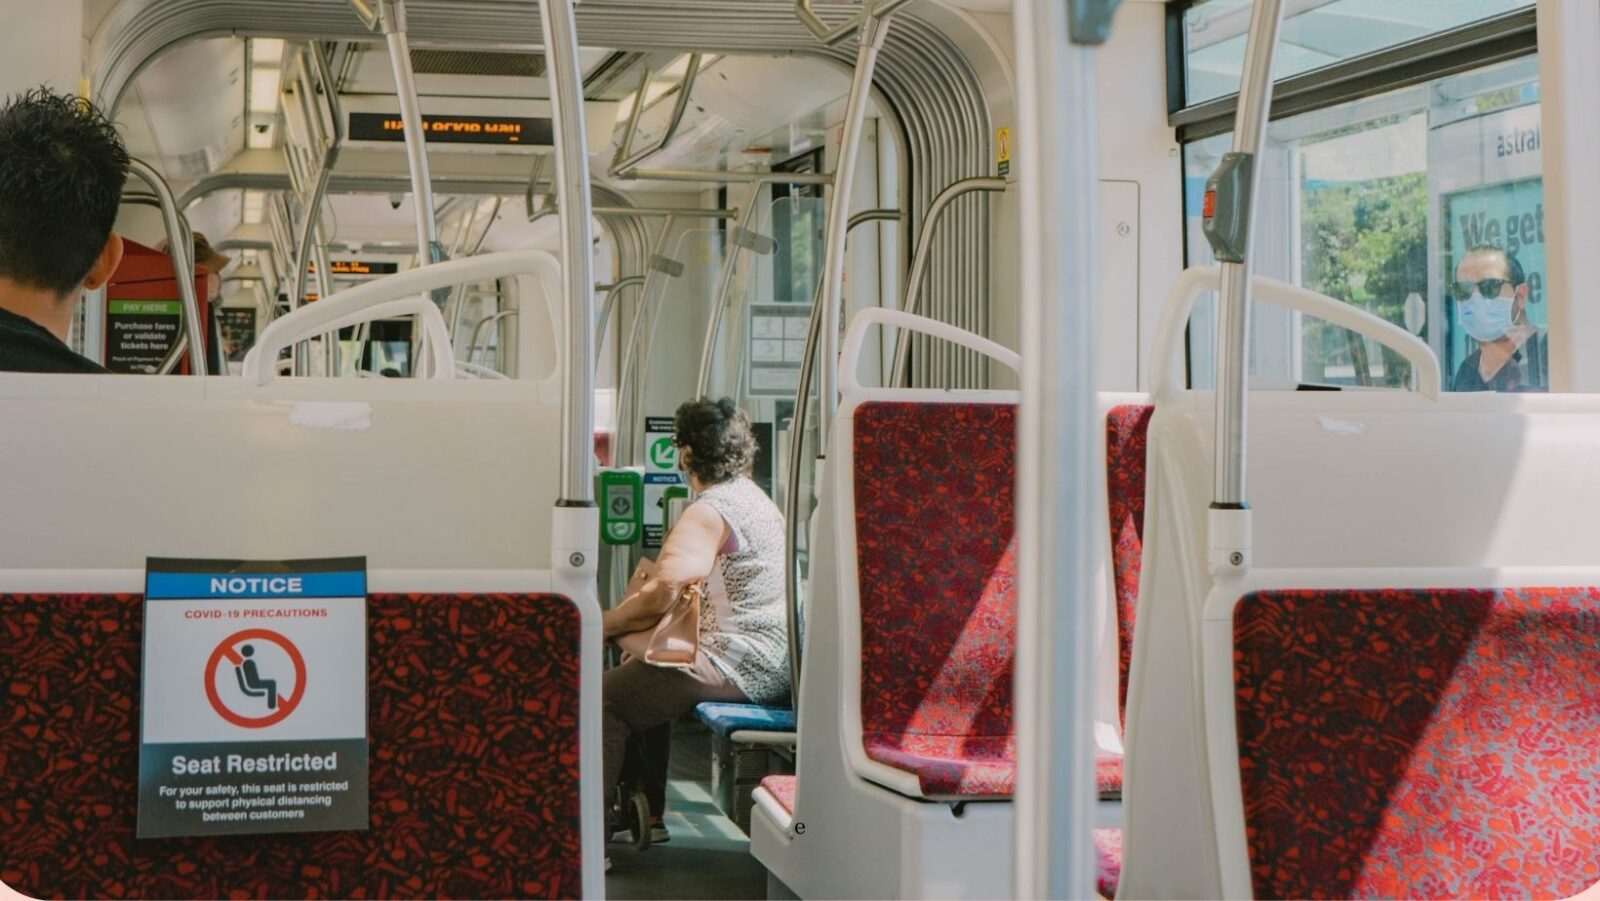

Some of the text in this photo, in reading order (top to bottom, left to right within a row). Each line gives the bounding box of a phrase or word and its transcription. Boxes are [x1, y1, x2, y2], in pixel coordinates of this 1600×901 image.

[1460, 204, 1544, 258] We get
[210, 577, 303, 593] NOTICE
[184, 608, 328, 619] COVID-19 PRECAUTIONS
[172, 752, 337, 774] Seat Restricted
[160, 781, 348, 797] For your safety, this seat is restricted
[176, 795, 332, 811] to support physical distancing
[203, 809, 304, 821] between customers
